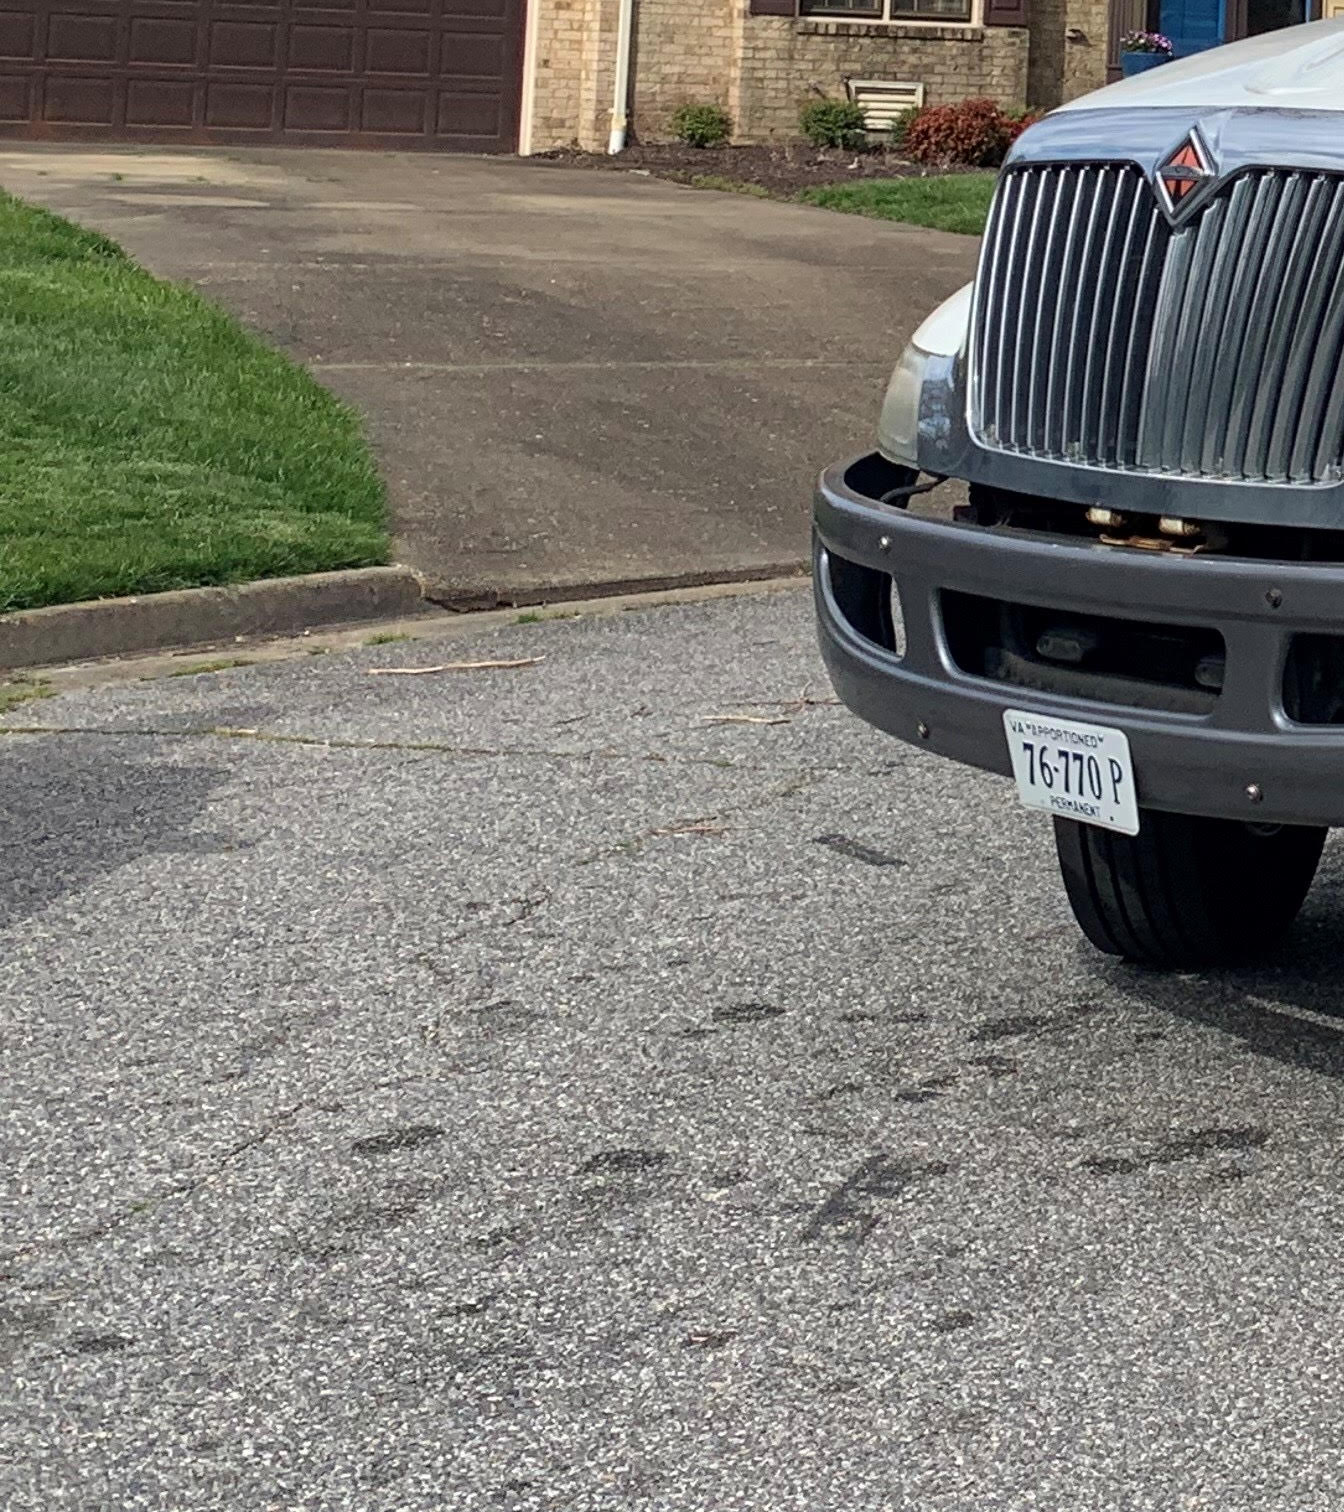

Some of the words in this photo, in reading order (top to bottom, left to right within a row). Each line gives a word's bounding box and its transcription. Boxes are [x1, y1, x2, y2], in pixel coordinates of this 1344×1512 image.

[1010, 721, 1025, 734] VA
[1022, 742, 1102, 800] 76-770
[1108, 757, 1123, 805] P
